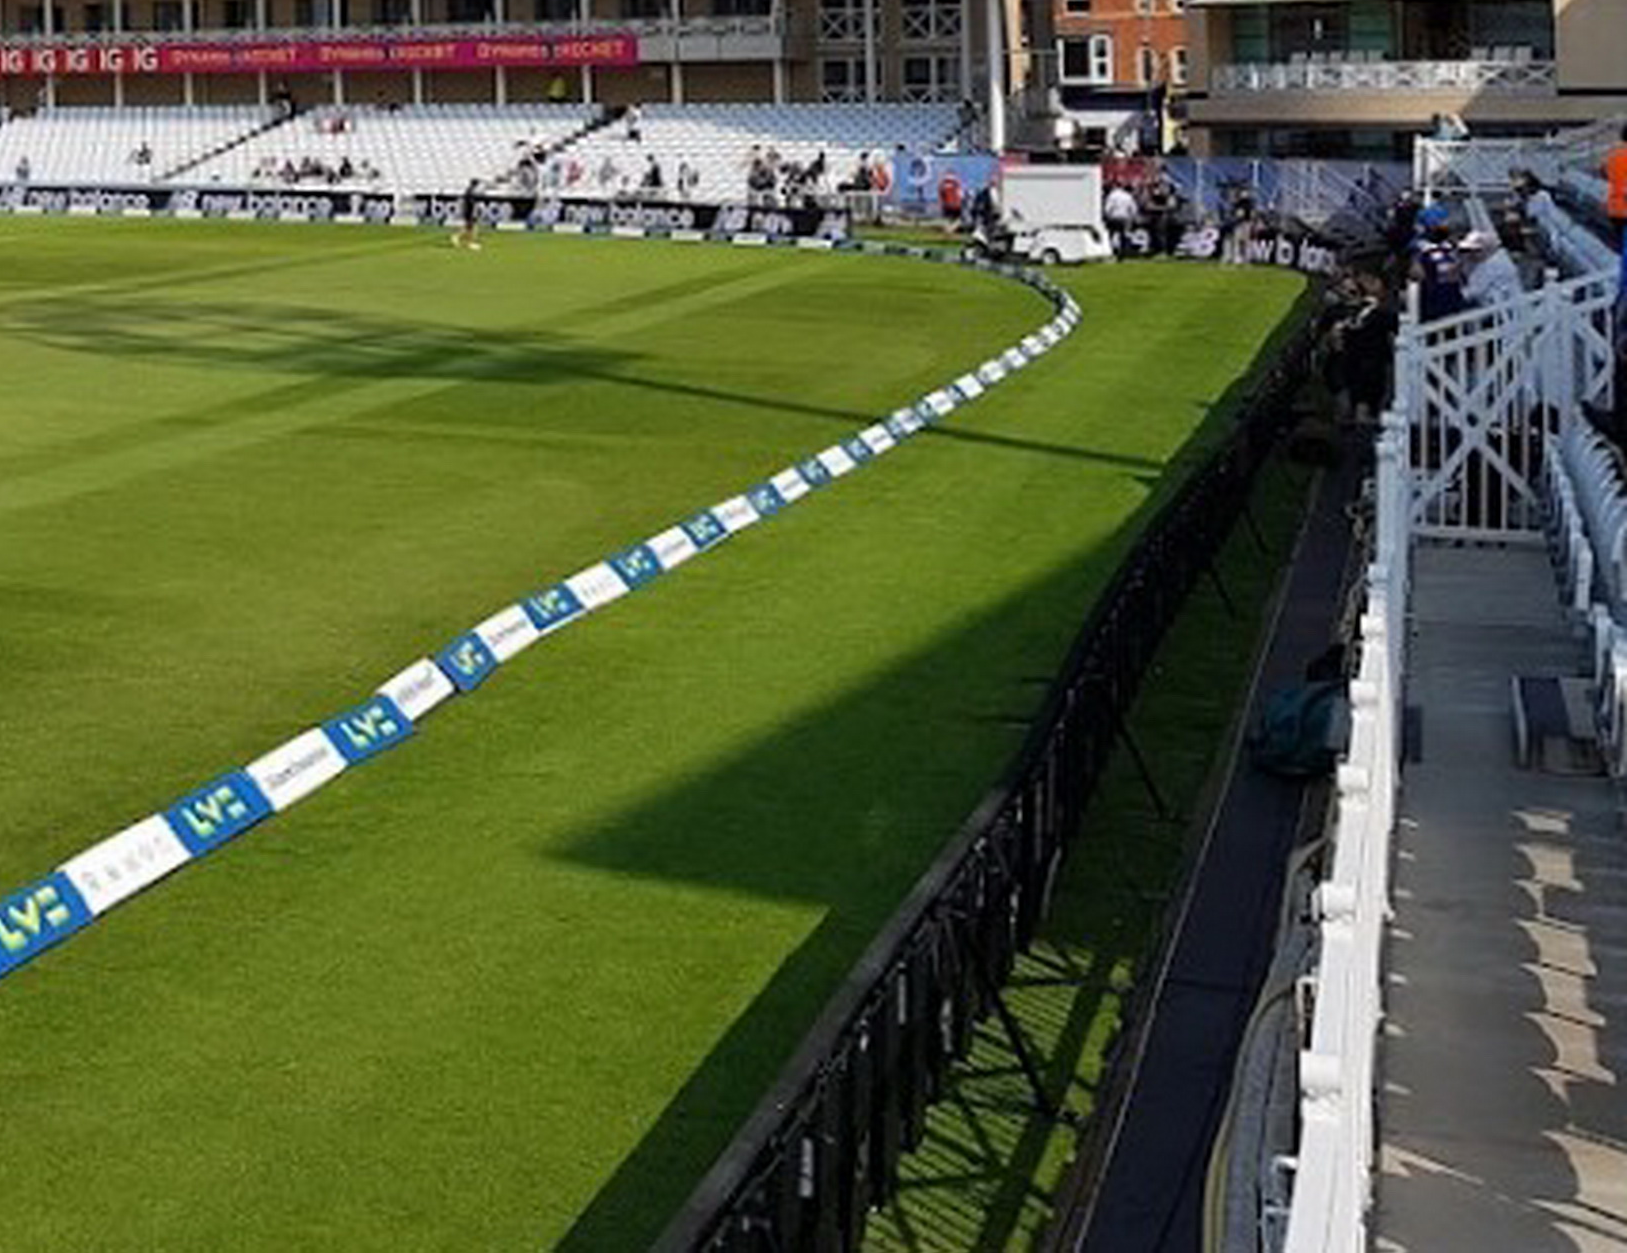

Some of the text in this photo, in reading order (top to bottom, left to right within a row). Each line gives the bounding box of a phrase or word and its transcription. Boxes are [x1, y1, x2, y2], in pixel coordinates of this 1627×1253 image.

[1, 50, 24, 73] IG
[32, 49, 56, 73] IG
[67, 49, 89, 72] IG
[100, 48, 122, 72] IG
[132, 47, 158, 72] IG
[610, 201, 694, 231] balance
